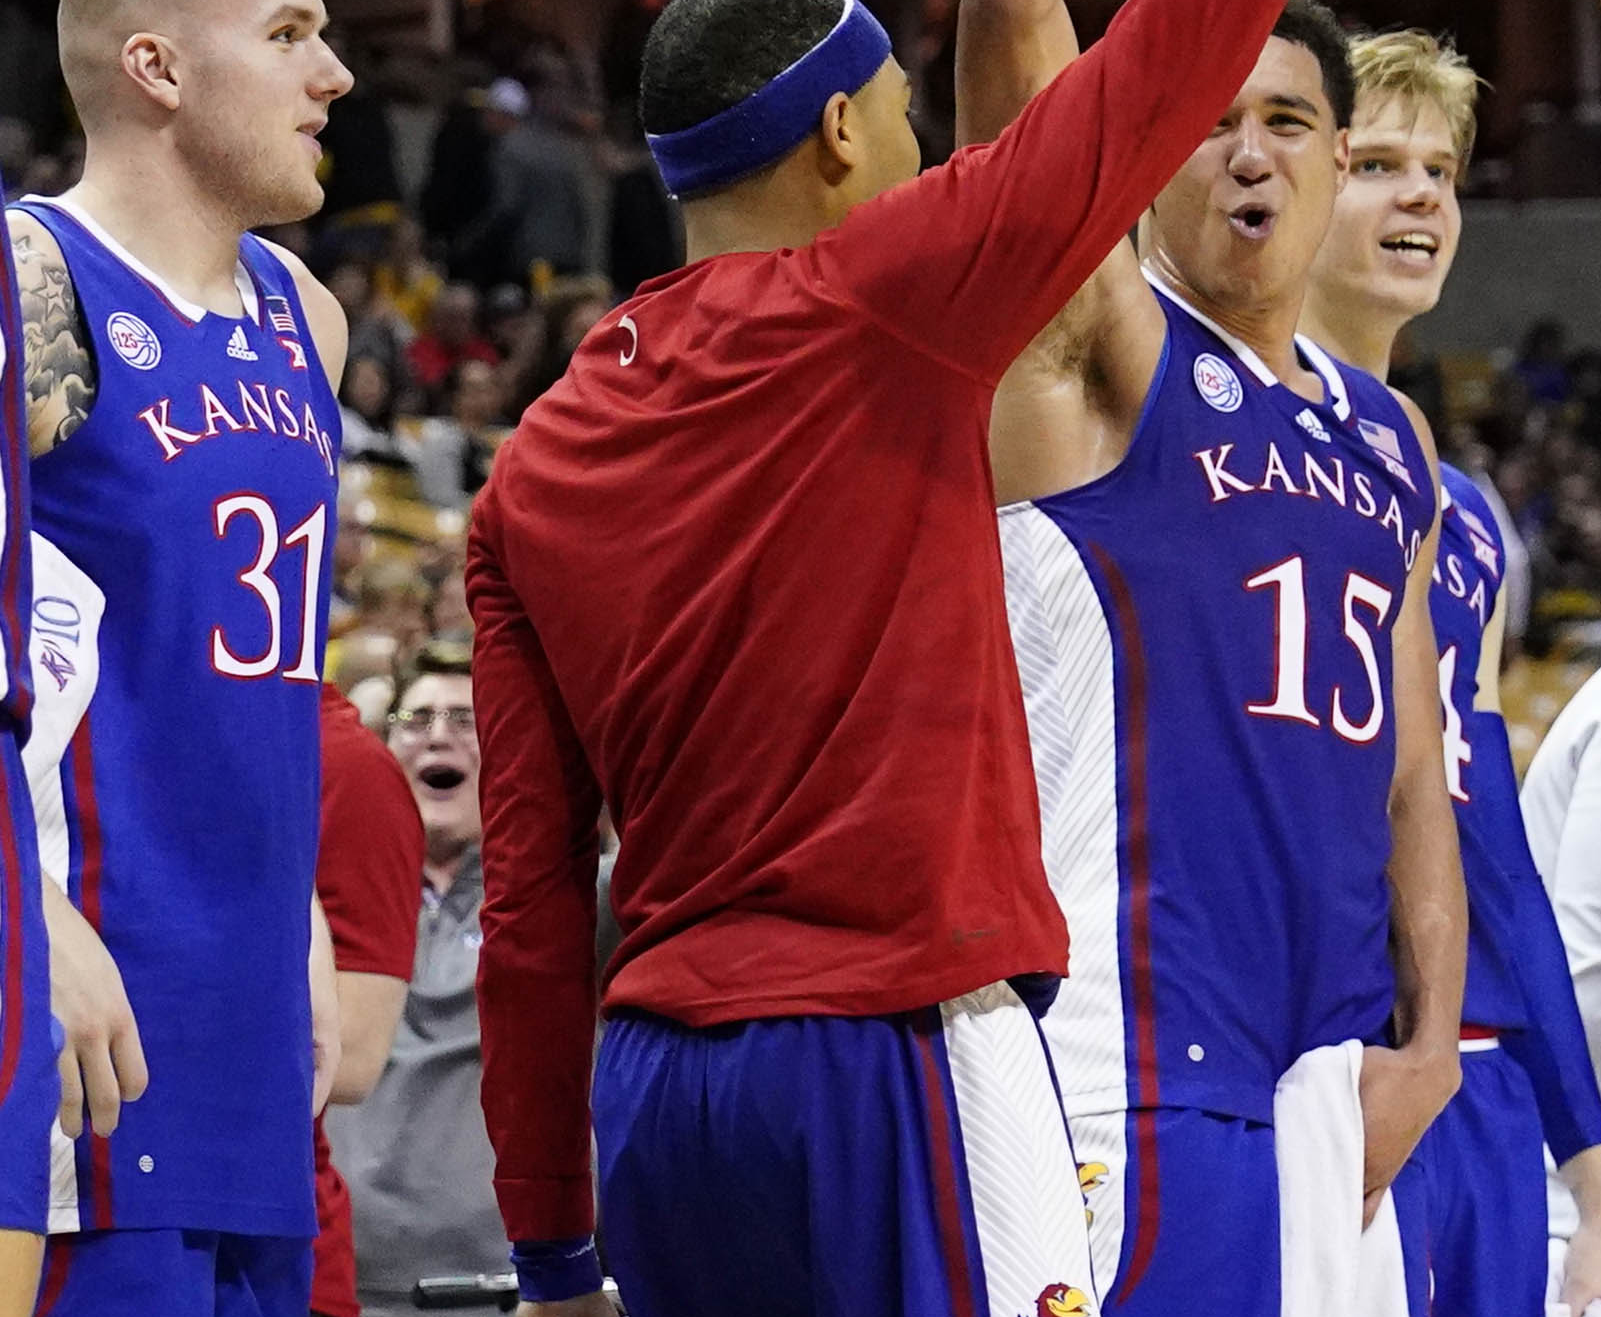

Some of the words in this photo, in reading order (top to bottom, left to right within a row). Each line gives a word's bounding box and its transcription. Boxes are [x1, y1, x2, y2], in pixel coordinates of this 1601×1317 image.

[138, 380, 335, 477] KANSAS
[1193, 442, 1421, 572] KANSAS
[211, 489, 328, 683] 31
[1243, 555, 1394, 745] 15
